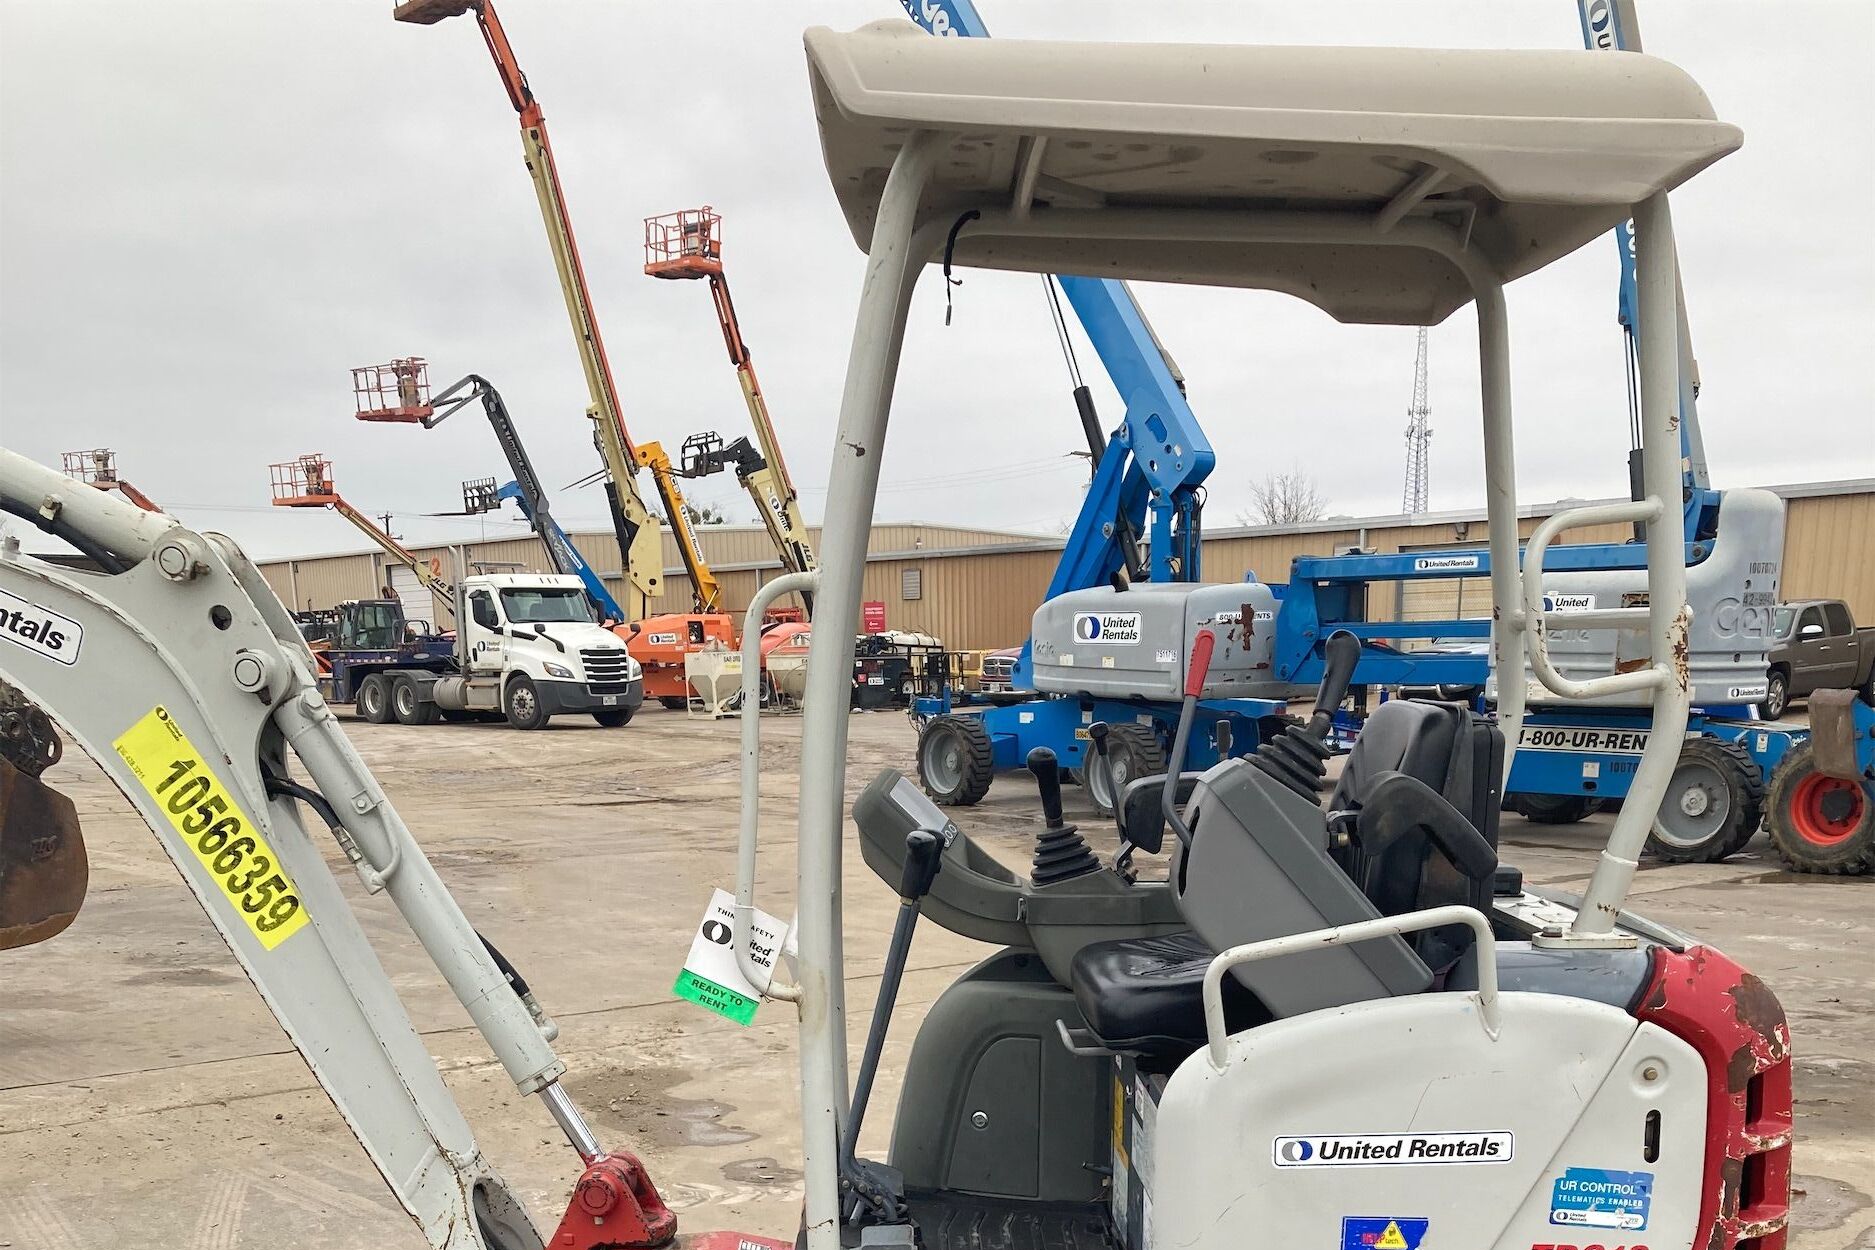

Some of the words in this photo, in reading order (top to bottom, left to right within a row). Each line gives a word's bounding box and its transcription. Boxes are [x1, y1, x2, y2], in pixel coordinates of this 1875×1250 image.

[801, 542, 813, 562] JLG
[431, 557, 441, 577] 2
[1429, 559, 1451, 568] United
[1450, 559, 1475, 567] Rentals
[431, 577, 447, 589] JLG
[1555, 597, 1589, 607] United
[0, 608, 65, 650] ntals
[1102, 616, 1136, 629] United
[1101, 629, 1139, 641] Rentals
[1518, 730, 1649, 750] 1-800-UR-REN
[154, 759, 299, 932] 10566359
[717, 906, 735, 919] THIN
[750, 924, 775, 940] AFETY
[749, 939, 772, 957] ited
[750, 953, 771, 968] tals
[692, 978, 727, 999] READY
[729, 994, 743, 1007] TO
[699, 993, 728, 1012] RENT
[1319, 1138, 1403, 1161] United
[1408, 1137, 1500, 1159] Rentals
[1560, 1180, 1578, 1192] UR
[1579, 1181, 1637, 1196] CONTROL
[1558, 1194, 1606, 1205] TELEMATICS
[1608, 1197, 1644, 1207] ENABLED
